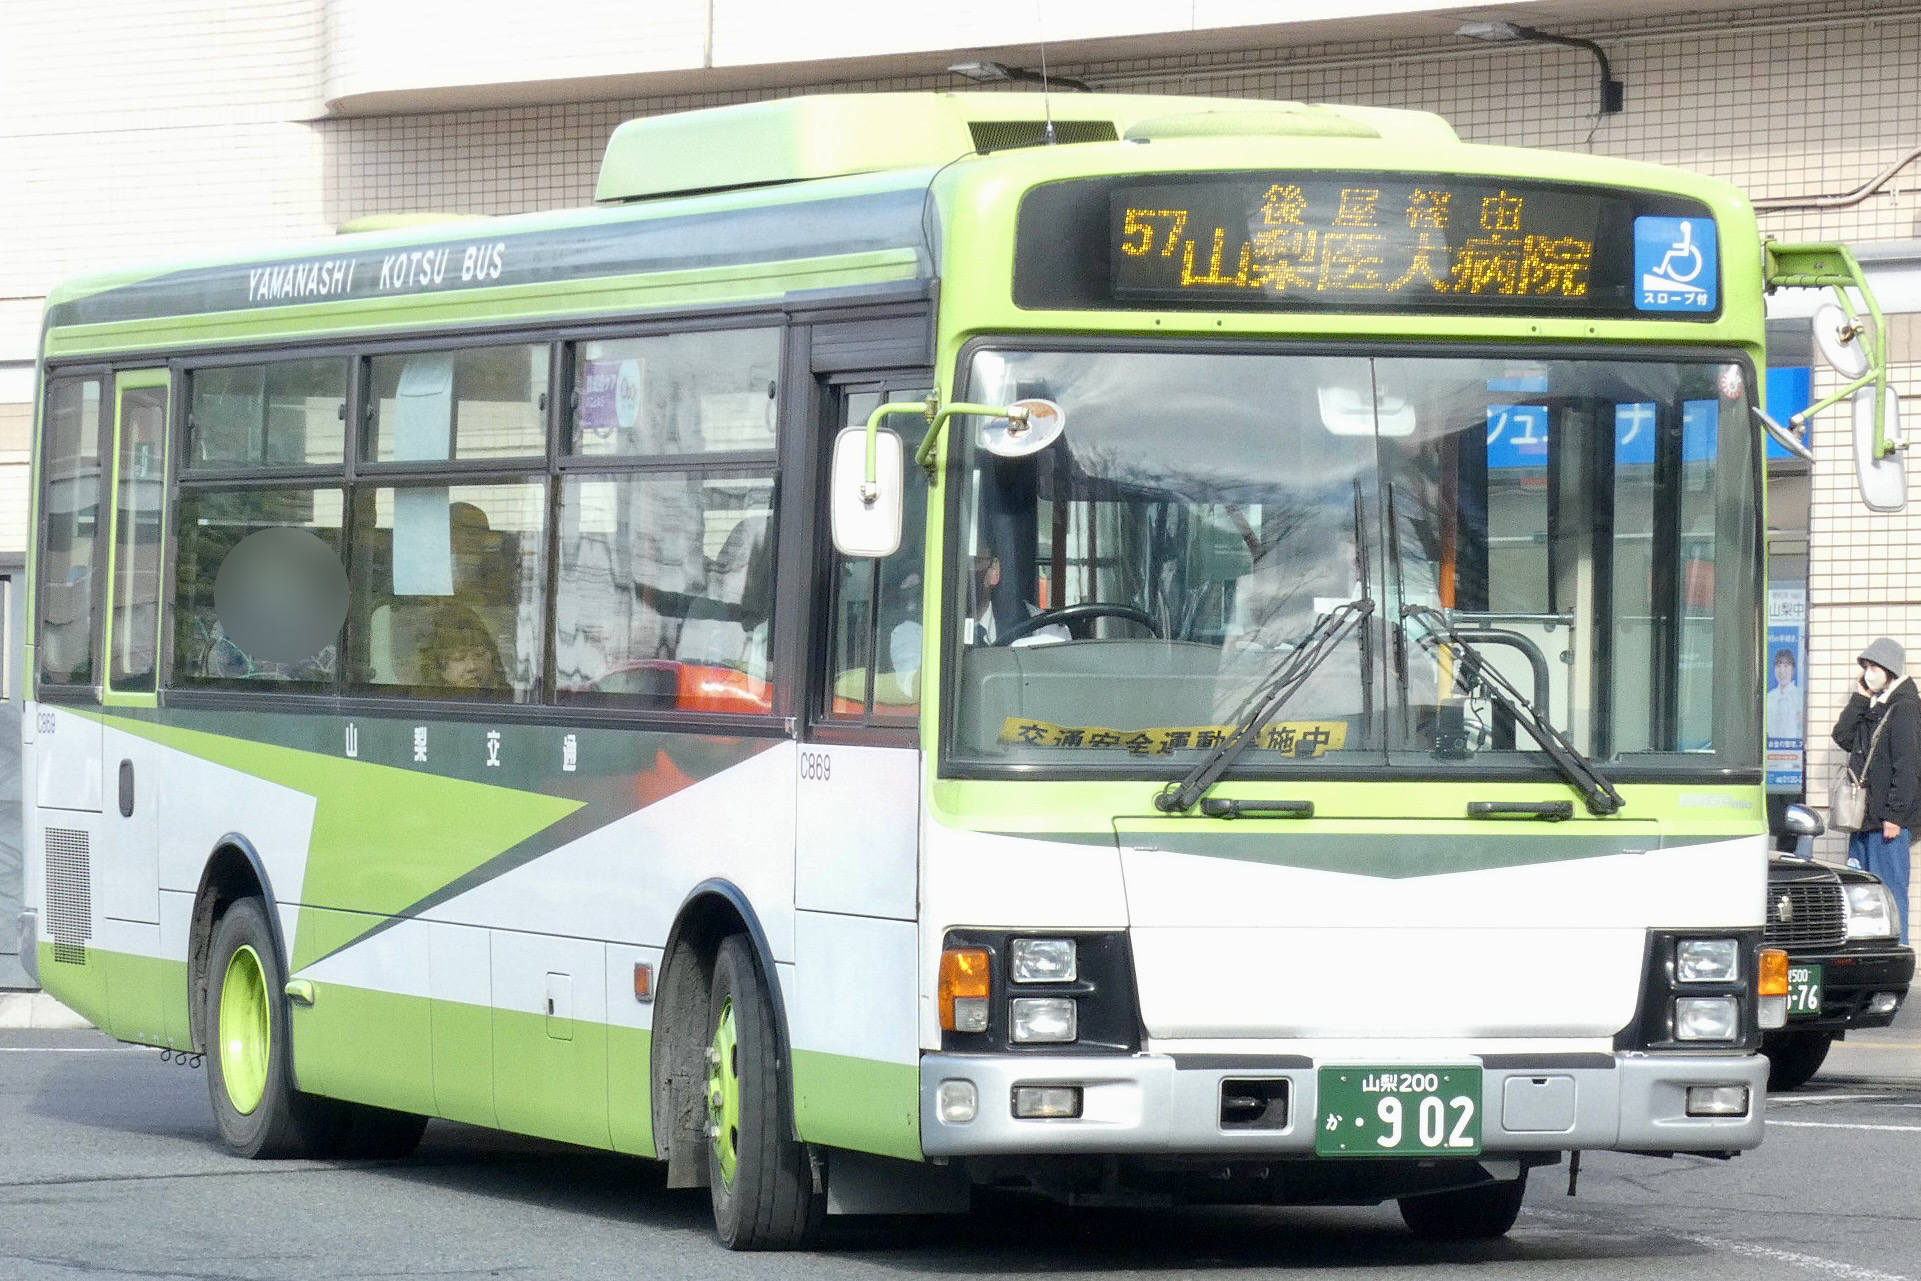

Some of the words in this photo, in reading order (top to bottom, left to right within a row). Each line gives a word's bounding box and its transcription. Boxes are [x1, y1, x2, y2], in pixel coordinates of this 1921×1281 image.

[1260, 184, 1524, 231] 後屋経由
[1122, 207, 1188, 256] 57
[1181, 227, 1593, 297] 山梨医大病院
[248, 258, 356, 301] YAMANASHI
[379, 248, 450, 291] KOTSU
[461, 242, 505, 281] BUS
[1643, 291, 1709, 306] スロープ付
[1017, 723, 1331, 757] 交通安全運動施中
[800, 752, 831, 781] C869
[1325, 1113, 1343, 1132] か
